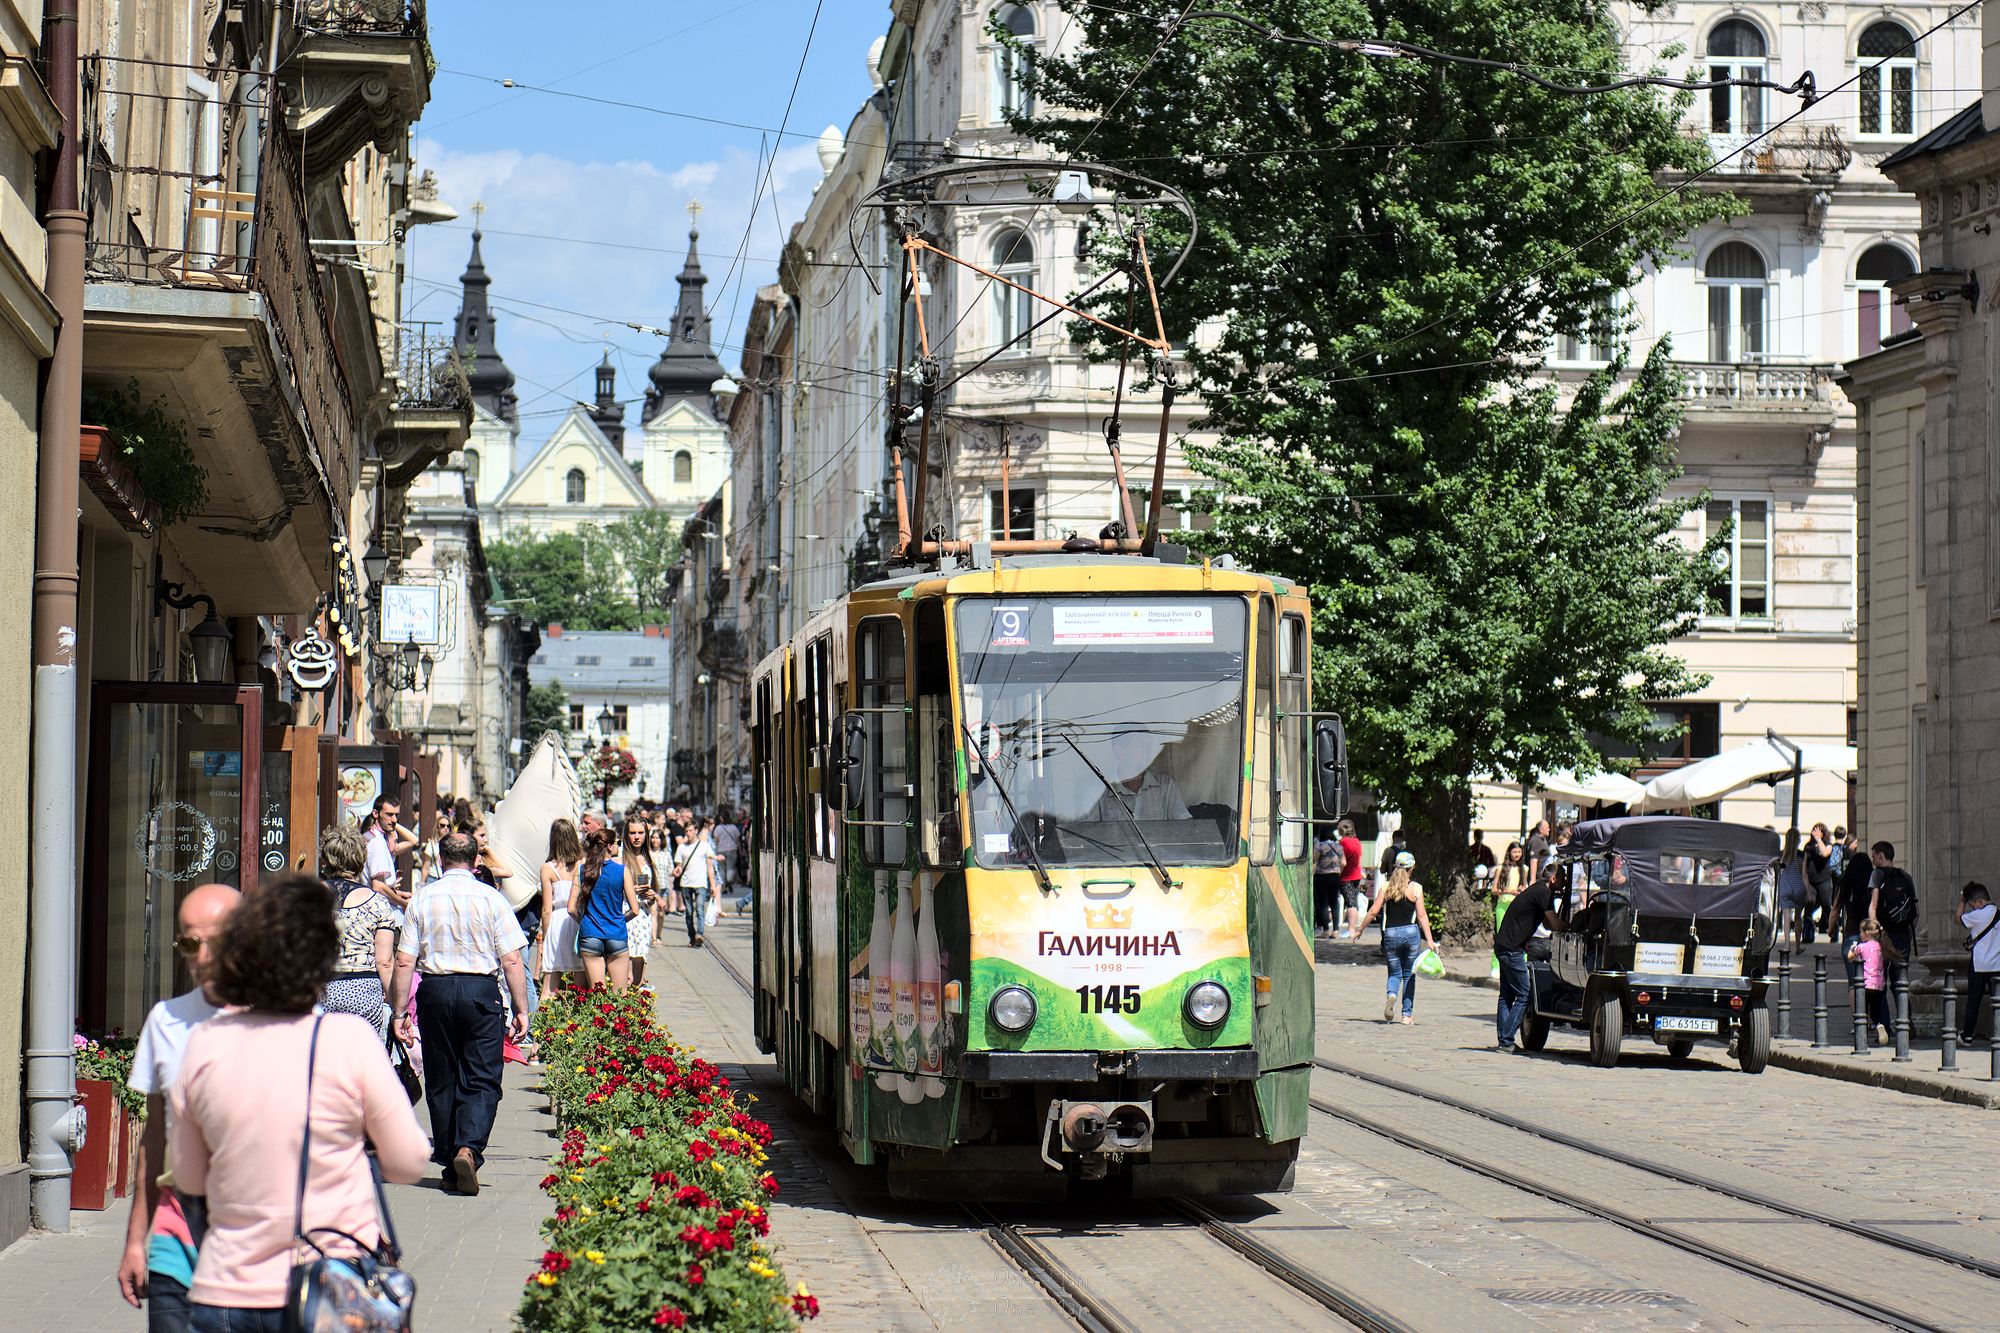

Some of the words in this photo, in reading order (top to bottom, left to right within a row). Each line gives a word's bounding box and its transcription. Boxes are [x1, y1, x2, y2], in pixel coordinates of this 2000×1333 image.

[1148, 610, 1171, 618] Площа
[1002, 611, 1020, 637] 9
[1038, 930, 1181, 956] ГАЛИЧИНА
[1095, 963, 1122, 973] 1998
[1076, 985, 1141, 1014] 1145
[896, 1013, 915, 1027] КЕФІР
[1662, 1017, 1677, 1028] BC
[1677, 1018, 1700, 1030] 6315
[1701, 1020, 1715, 1031] ET
